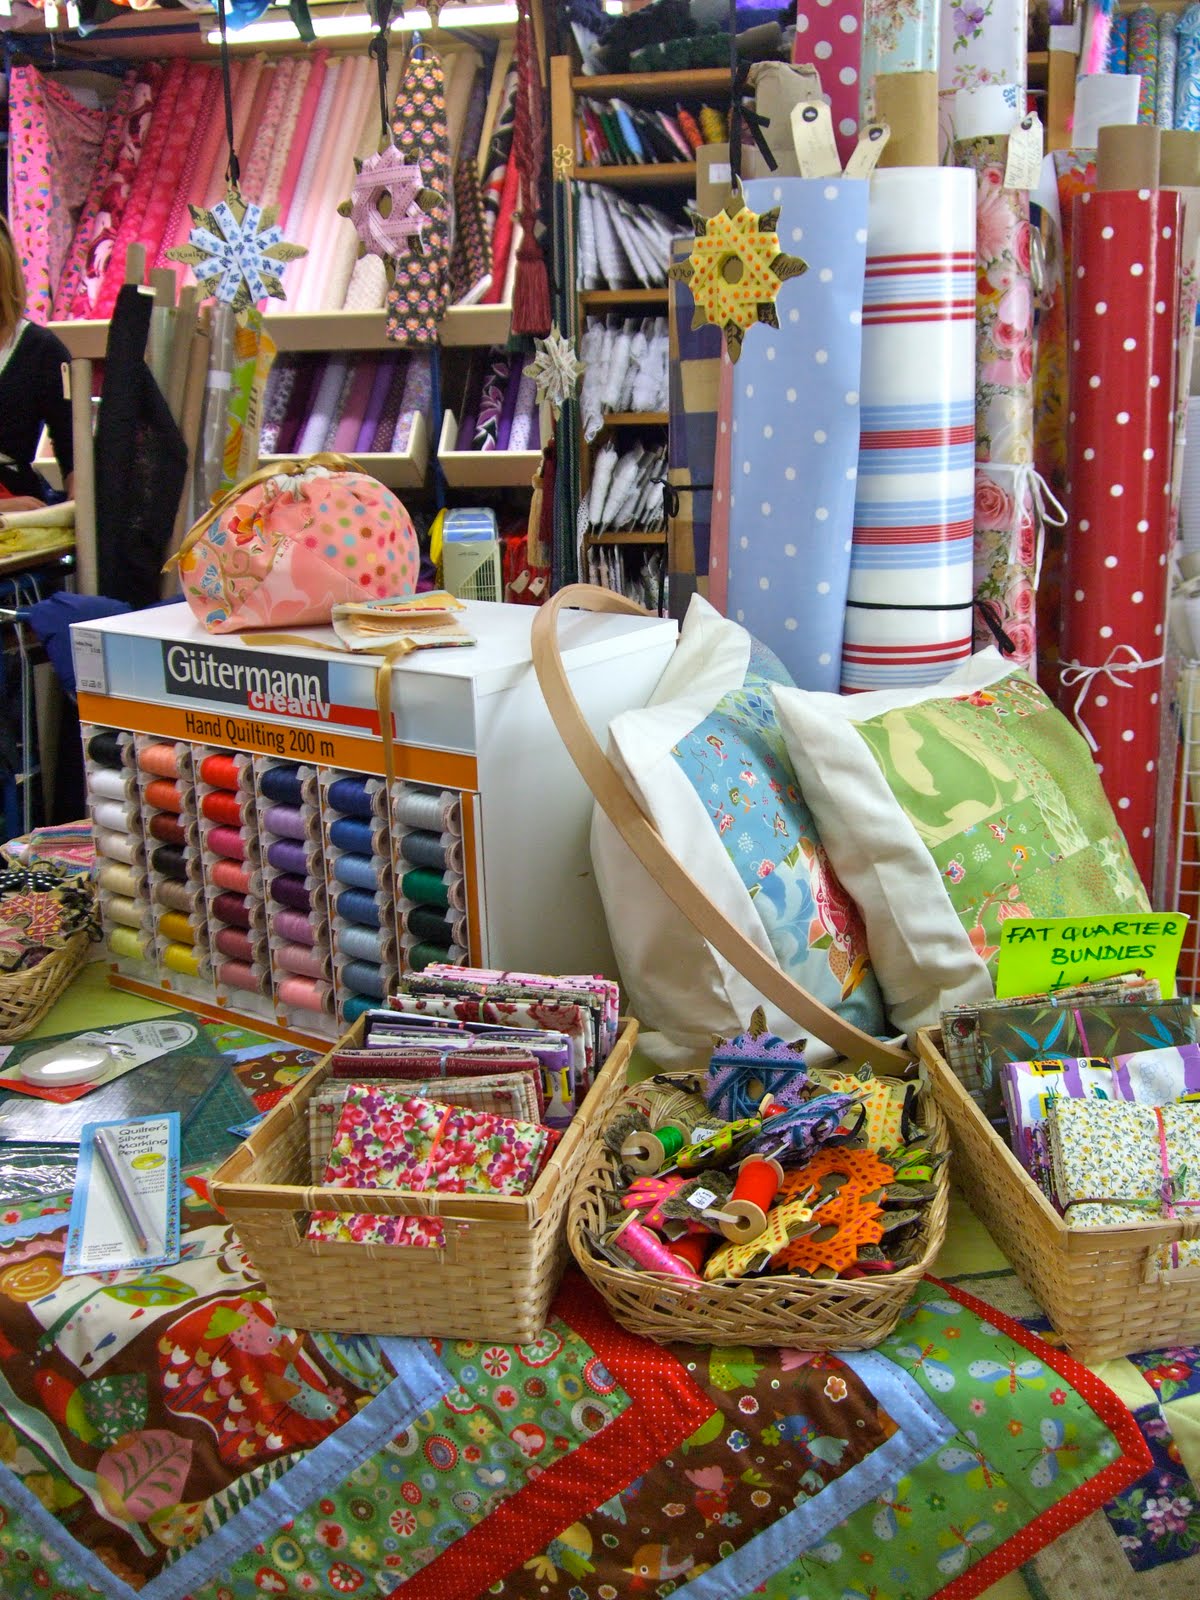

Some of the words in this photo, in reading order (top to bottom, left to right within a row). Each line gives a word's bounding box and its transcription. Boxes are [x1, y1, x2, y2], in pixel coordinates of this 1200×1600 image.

[167, 645, 323, 703] Gütermann
[250, 691, 331, 719] creativ
[185, 712, 222, 738] Hand
[226, 719, 286, 755] Quilting
[289, 729, 316, 755] 200
[320, 739, 336, 758] m
[1006, 926, 1056, 944] FAT
[1061, 921, 1178, 943] QUARTER
[1050, 944, 1157, 966] BUNDLES
[118, 1134, 150, 1144] Silver
[119, 1123, 168, 1136] Quilter's
[117, 1146, 153, 1156] Pencil
[118, 1139, 168, 1149] Marking
